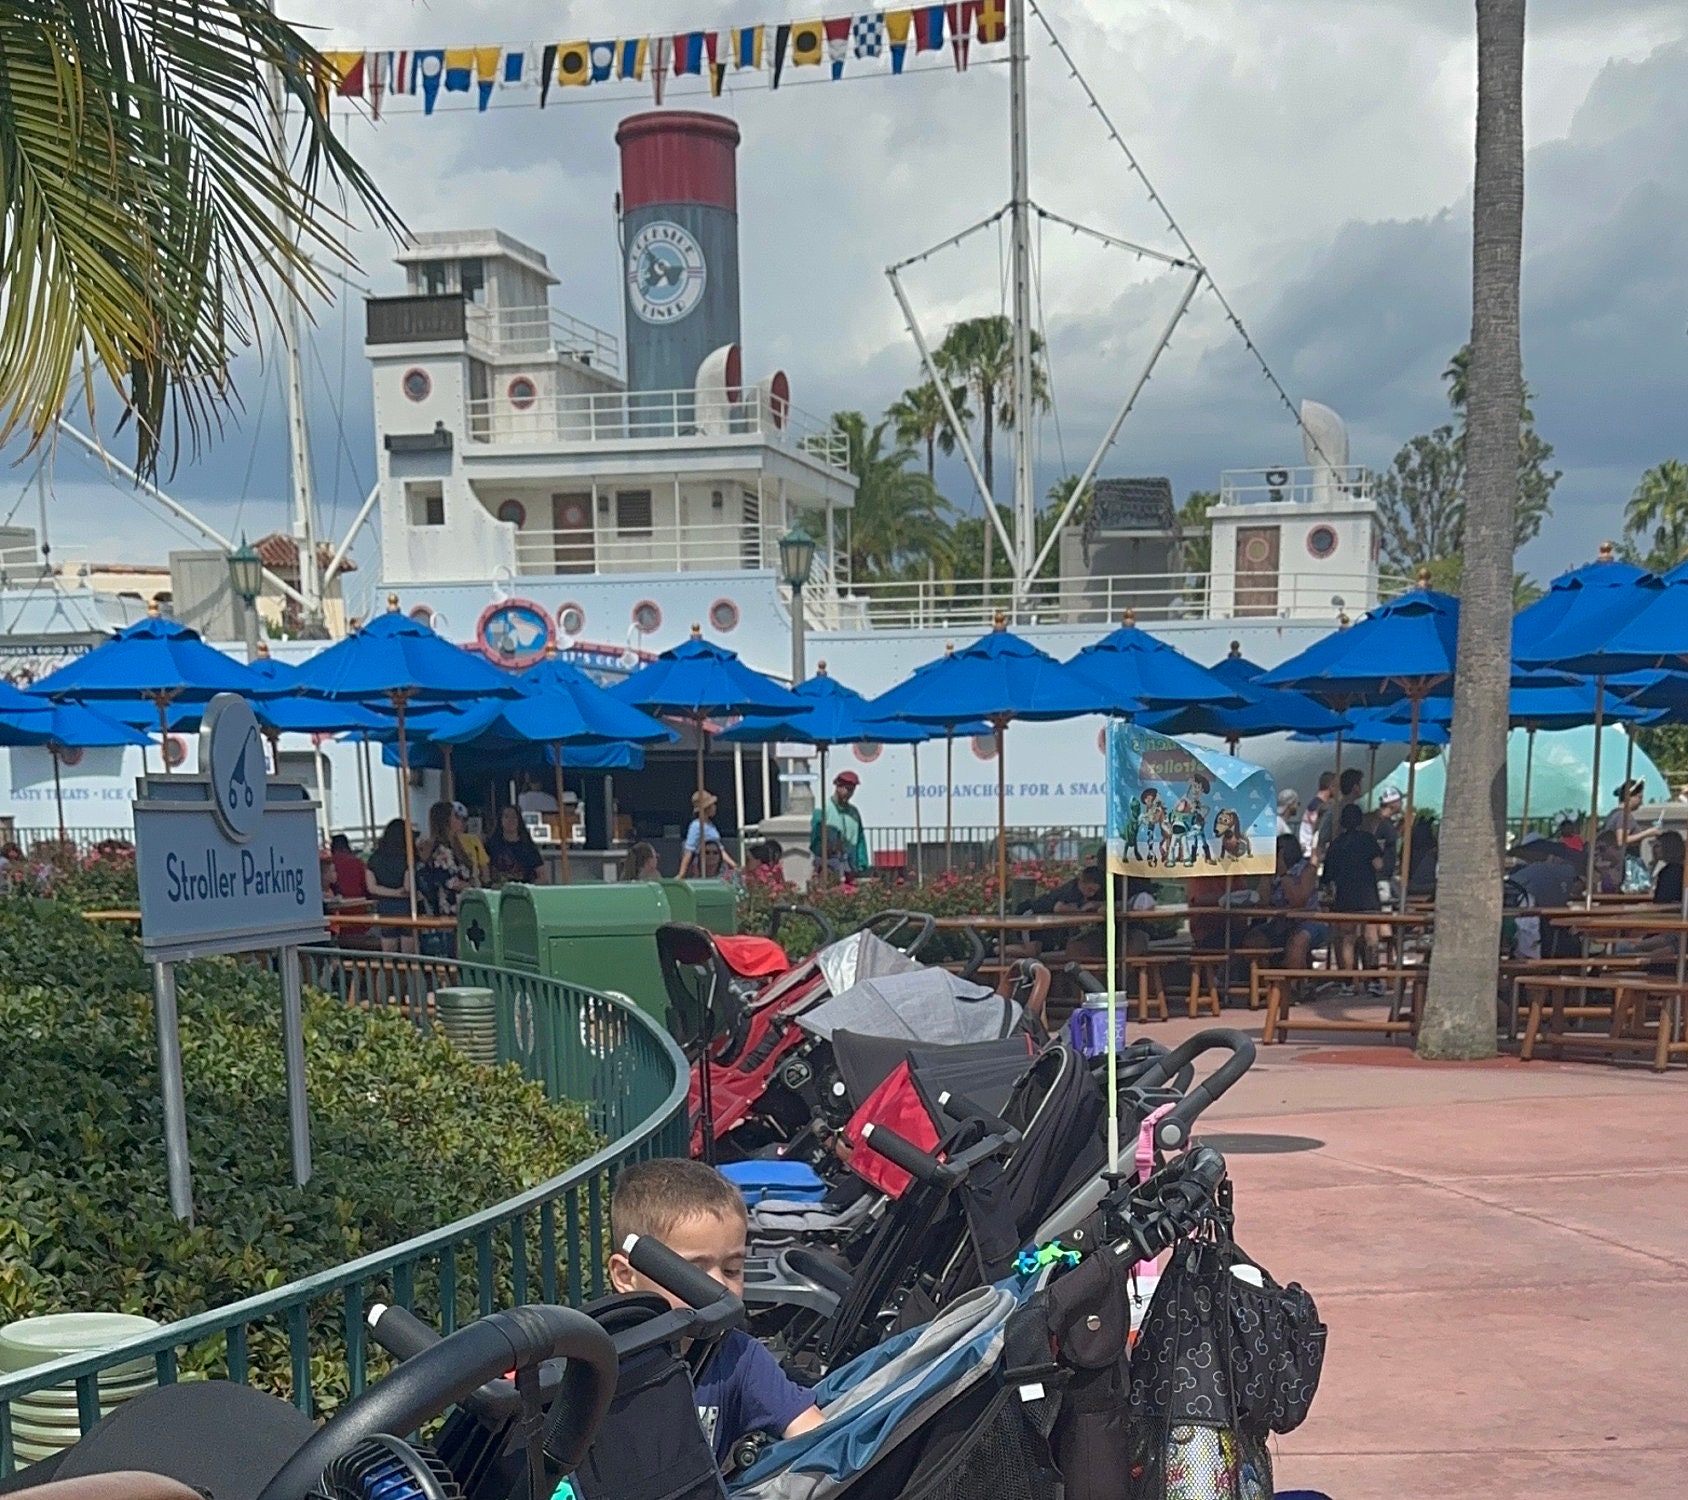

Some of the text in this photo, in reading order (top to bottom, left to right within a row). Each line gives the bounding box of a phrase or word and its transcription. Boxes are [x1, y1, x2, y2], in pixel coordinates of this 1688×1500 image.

[641, 301, 687, 318] DINER
[101, 788, 124, 800] ICE
[906, 784, 947, 798] DROP
[1019, 783, 1049, 796] FOR
[1054, 783, 1065, 796] A
[1070, 782, 1107, 796] SNAC
[165, 846, 306, 905] Stroller Parking
